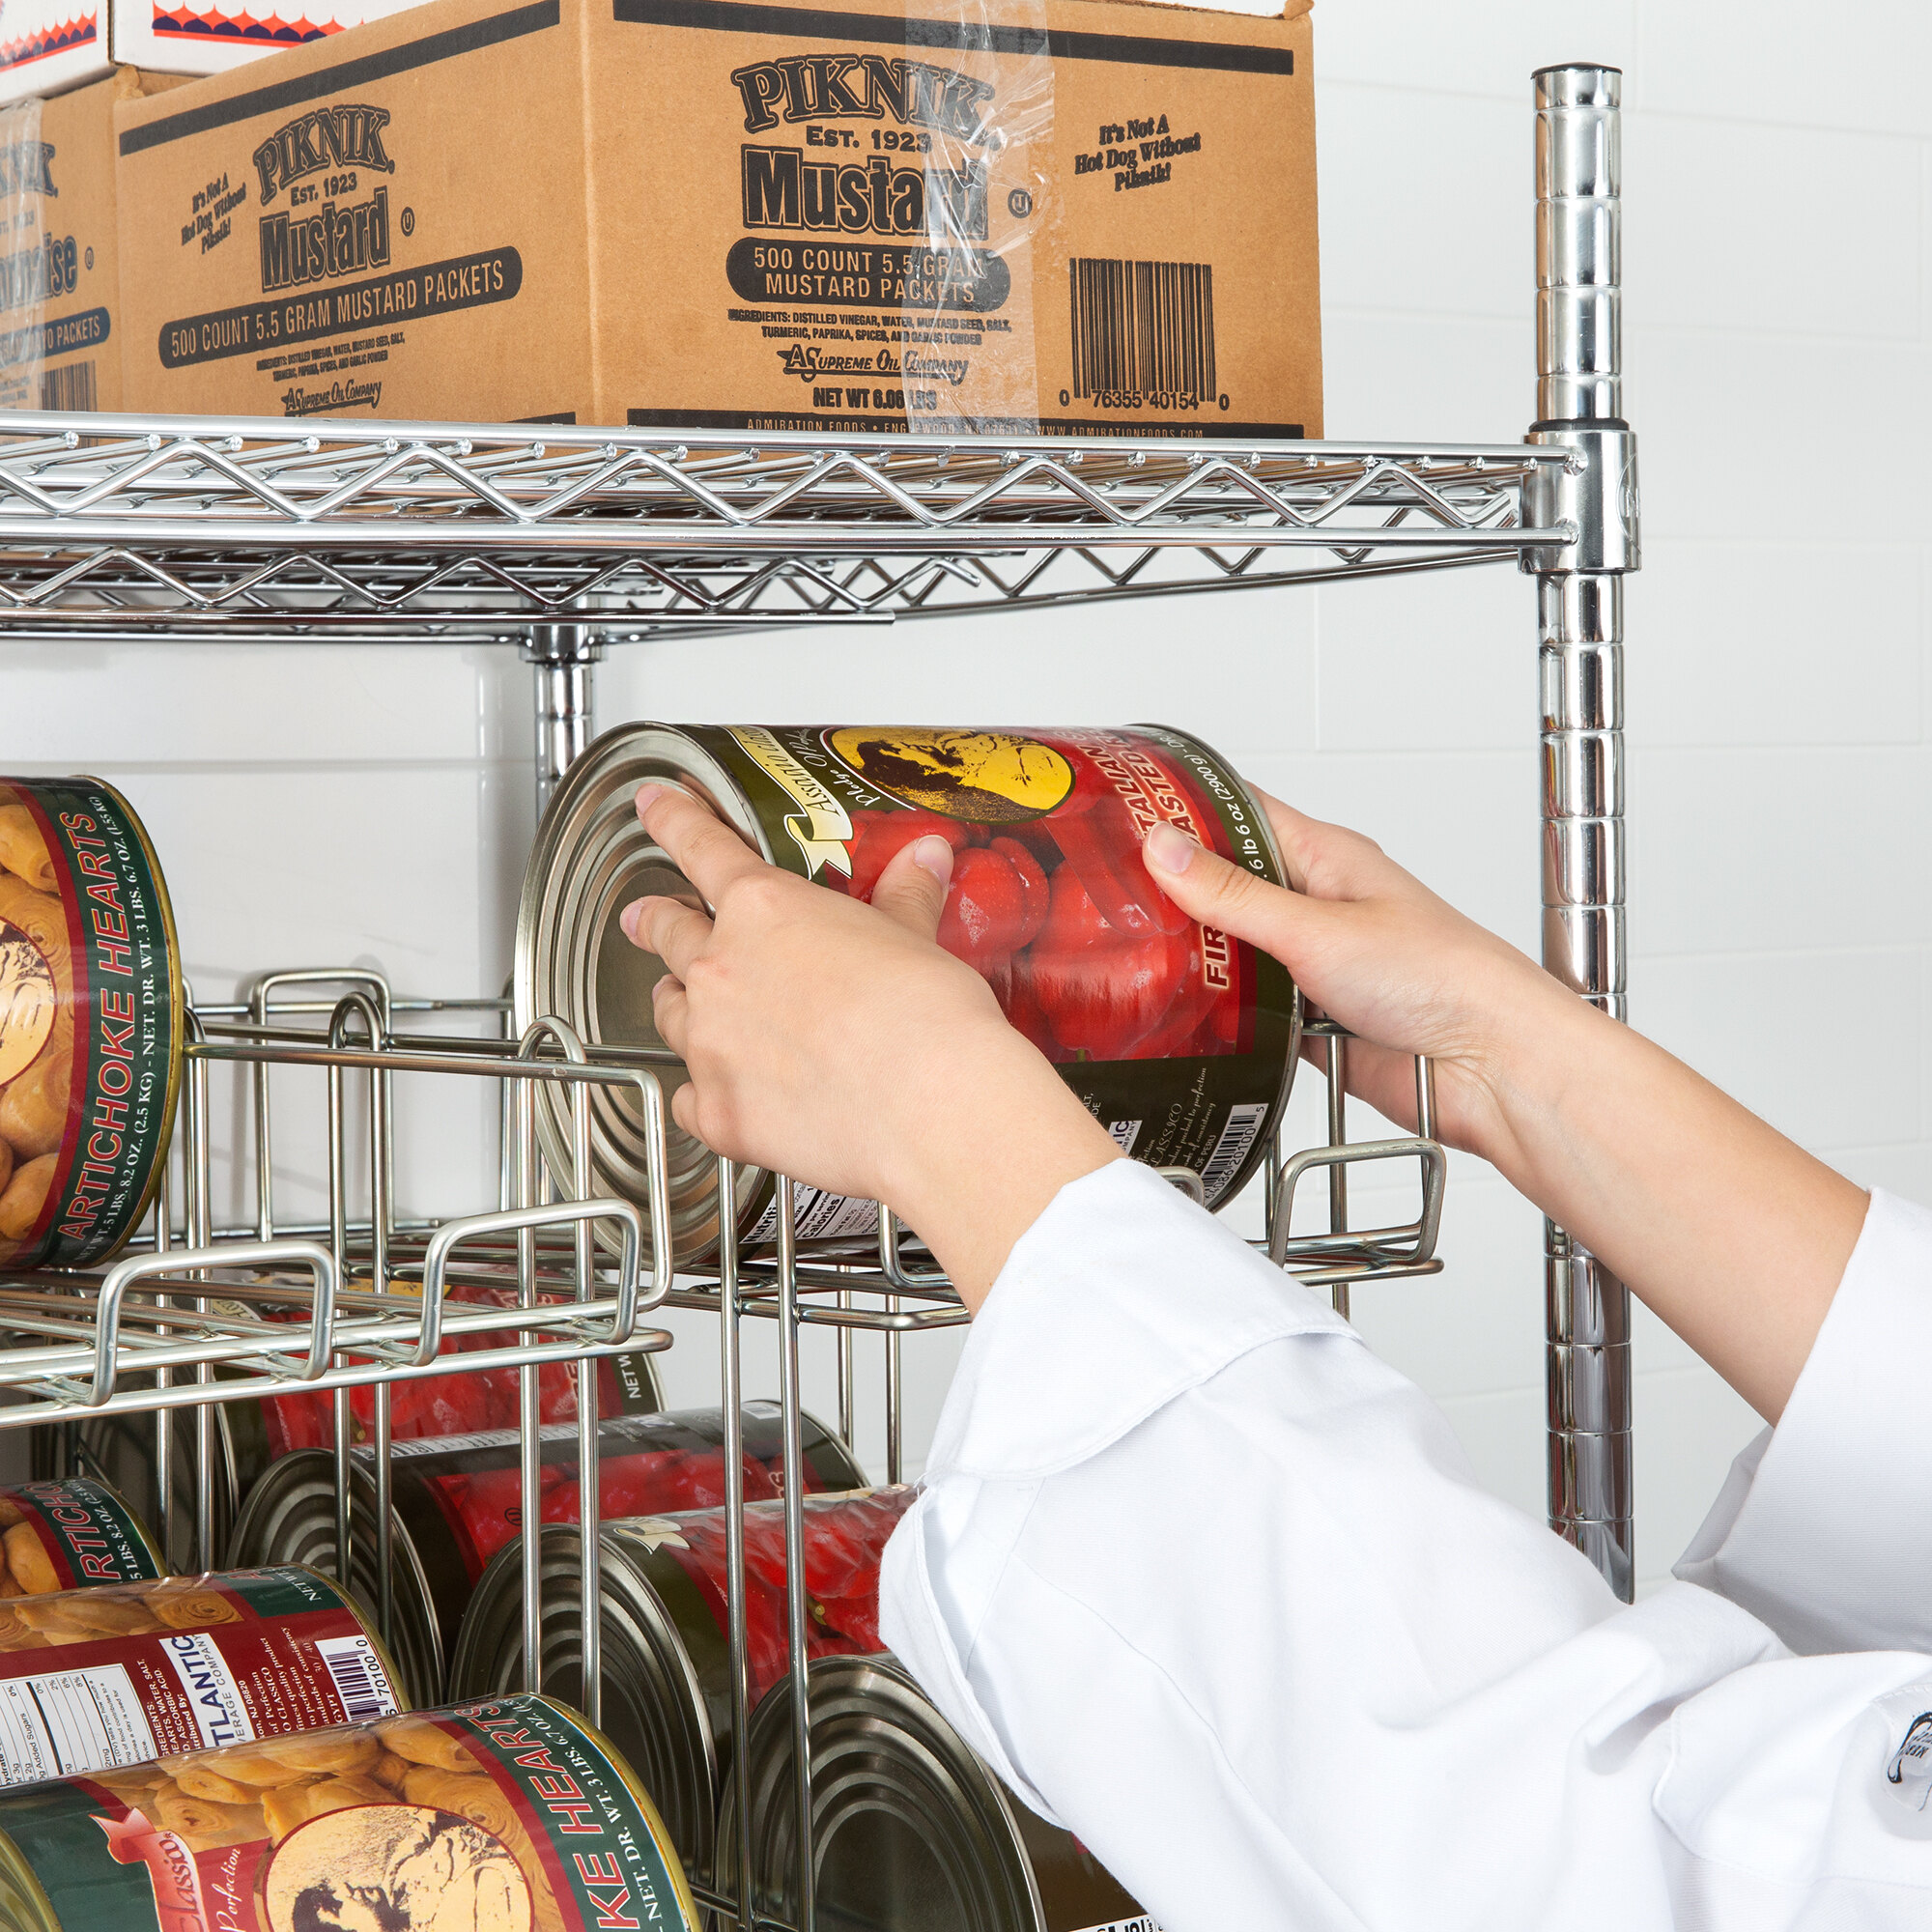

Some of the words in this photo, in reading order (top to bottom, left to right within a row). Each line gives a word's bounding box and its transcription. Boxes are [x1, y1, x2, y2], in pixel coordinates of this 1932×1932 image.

[730, 53, 996, 146] PIKNIK
[806, 126, 860, 149] EST.
[871, 129, 933, 153] 1923
[1126, 117, 1155, 140] Not
[1156, 114, 1170, 134] A
[252, 103, 389, 206] PIKNIK
[1074, 152, 1103, 175] Hot
[1106, 149, 1138, 169] Dog
[1139, 132, 1202, 161] Without
[291, 185, 319, 206] EST.
[324, 172, 357, 198] 1923
[741, 144, 988, 242] Mustard
[197, 211, 213, 232] Dog
[259, 185, 390, 293] Mustard
[753, 247, 793, 270] 500
[803, 249, 872, 273] COUNT
[882, 253, 913, 275] 5.5
[923, 254, 982, 278] GRAM
[765, 272, 870, 298] MUSTARD
[881, 279, 974, 302] PACKETS
[171, 328, 196, 357] 500
[202, 316, 248, 351] COUNT
[256, 309, 279, 340] 5.5
[286, 299, 330, 333] GRAM
[337, 278, 417, 324] MUSTARD
[425, 260, 504, 302] PACKETS
[727, 308, 791, 323] INGREDIENTS:
[792, 312, 838, 325] DISTILLED
[839, 314, 881, 327] VINEGAR,
[57, 315, 100, 348] PACKETS
[761, 326, 810, 340] TURMERIC,
[812, 327, 854, 341] PAPRIKA,
[855, 329, 890, 343] SPICES,
[891, 330, 910, 343] AND
[813, 386, 842, 408] NET
[846, 387, 870, 408] WT
[1059, 389, 1069, 407] 0
[1093, 390, 1143, 409] 76355
[1150, 391, 1199, 411] 40154
[1219, 393, 1230, 411] 0
[747, 418, 822, 433] ADMIRATION
[829, 420, 867, 433] FOODS
[1038, 425, 1204, 438] WWWADMIRATIONFOODSCOM
[829, 769, 881, 807] Pledge
[1076, 745, 1159, 838] TALIAN
[1119, 751, 1205, 840] ASTED
[1197, 767, 1235, 801] (2900
[1227, 803, 1244, 822] oz
[1235, 824, 1251, 836] 6
[1242, 837, 1259, 855] lb
[114, 838, 131, 862] OZ.
[1249, 858, 1264, 870] 6
[123, 865, 138, 883] 6.7
[59, 811, 133, 977] HEARTS
[129, 886, 147, 921] LBS.
[136, 923, 149, 934] 3
[139, 936, 153, 969] WT.
[1201, 923, 1230, 990] FIR
[142, 974, 155, 1006] DR.
[138, 1072, 156, 1104] KG)
[58, 988, 135, 1241] ARTICHOKE
[134, 1107, 149, 1134] (2.5
[1150, 1103, 1183, 1167] LASSICO
[1202, 1134, 1216, 1156] PERU
[1229, 1127, 1257, 1165] 20100
[127, 1139, 143, 1166] OZ.
[119, 1169, 135, 1188] 8.2
[107, 1190, 128, 1217] LBS.
[803, 1198, 840, 1237] Calories
[744, 1206, 776, 1243] Nutriti
[621, 1369, 642, 1399] NET
[95, 1505, 114, 1523] OZ.
[25, 1486, 122, 1579] RTICHO
[106, 1523, 124, 1539] 8.2
[118, 1541, 139, 1570] LBS.
[292, 1581, 323, 1603] NET
[193, 1634, 226, 1686] COMPANY
[260, 1637, 284, 1670] product
[281, 1626, 310, 1672] consistency
[171, 1635, 235, 1747] TLANTIC
[238, 1680, 254, 1704] 08820
[277, 1670, 298, 1704] quality
[290, 1666, 315, 1715] perfection
[303, 1673, 314, 1685] of
[364, 1655, 390, 1697] 70100
[177, 1693, 187, 1709] By:
[251, 1671, 275, 1719] Perfection
[260, 1666, 289, 1719] CLASSICO
[310, 1685, 330, 1725] andards
[326, 1691, 344, 1723] GYPT
[19, 1713, 34, 1740] Sugars
[147, 1701, 171, 1757] GREDIENTS:
[164, 1690, 187, 1739] ASCORBIC
[222, 1691, 247, 1743] ERAGE
[250, 1707, 260, 1719] NJ
[269, 1721, 280, 1734] of
[309, 1715, 318, 1726] to
[526, 1712, 552, 1730] OZ.
[182, 1711, 202, 1749] tributed
[545, 1731, 568, 1747] 6.7
[30, 1742, 43, 1769] Added
[455, 1704, 605, 1833] HEARTS
[564, 1747, 597, 1777] LBS.
[587, 1776, 604, 1787] 3
[595, 1789, 622, 1824] WT.
[617, 1826, 642, 1863] DR.
[633, 1865, 664, 1921] NET.
